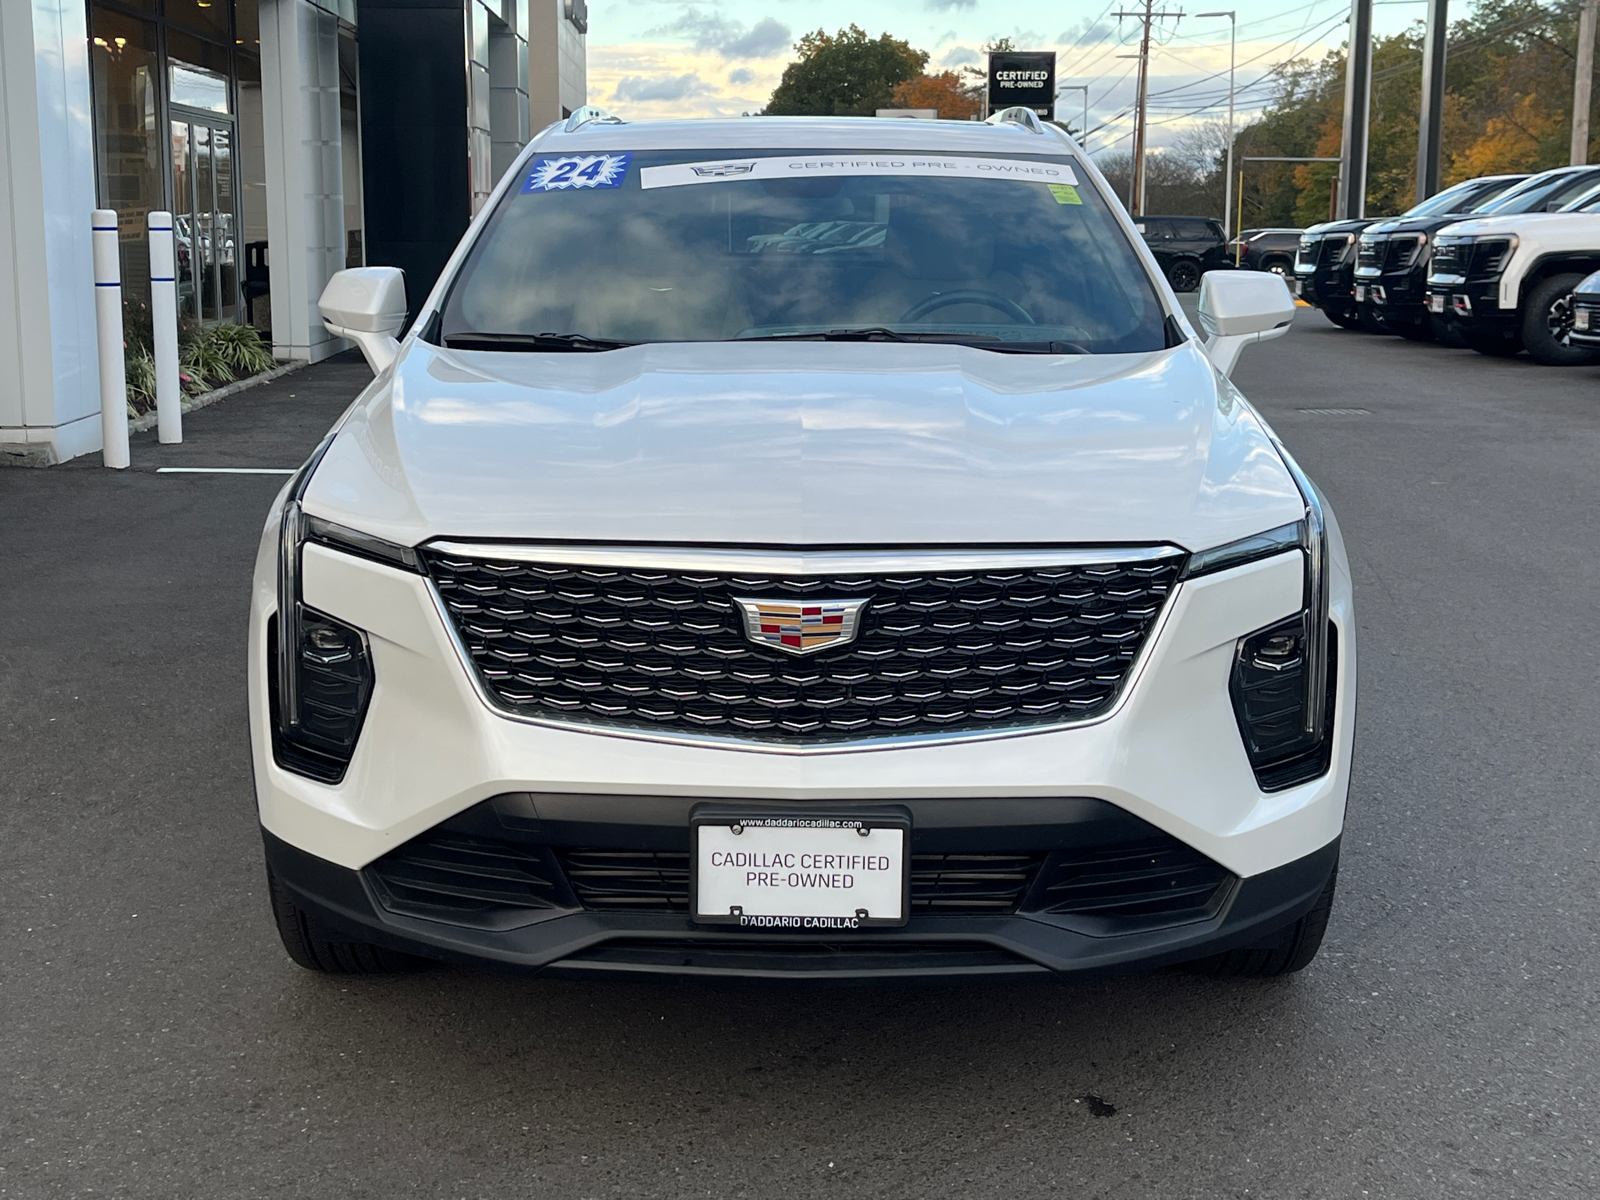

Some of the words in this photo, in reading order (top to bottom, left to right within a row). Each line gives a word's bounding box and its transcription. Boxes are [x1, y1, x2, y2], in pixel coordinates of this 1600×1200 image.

[996, 71, 1048, 80] CERTIFIED
[547, 160, 605, 184] 24
[788, 161, 905, 170] CERTIFIED
[976, 164, 1060, 176] OWNED
[739, 818, 862, 829] www.daddariocadillac.com
[711, 851, 795, 868] CADILLAC
[801, 853, 889, 871] CERTIFIED
[746, 872, 854, 888] PRE-OWNED
[740, 915, 800, 927] D'ADDARIO
[803, 917, 859, 929] CADILLAC
